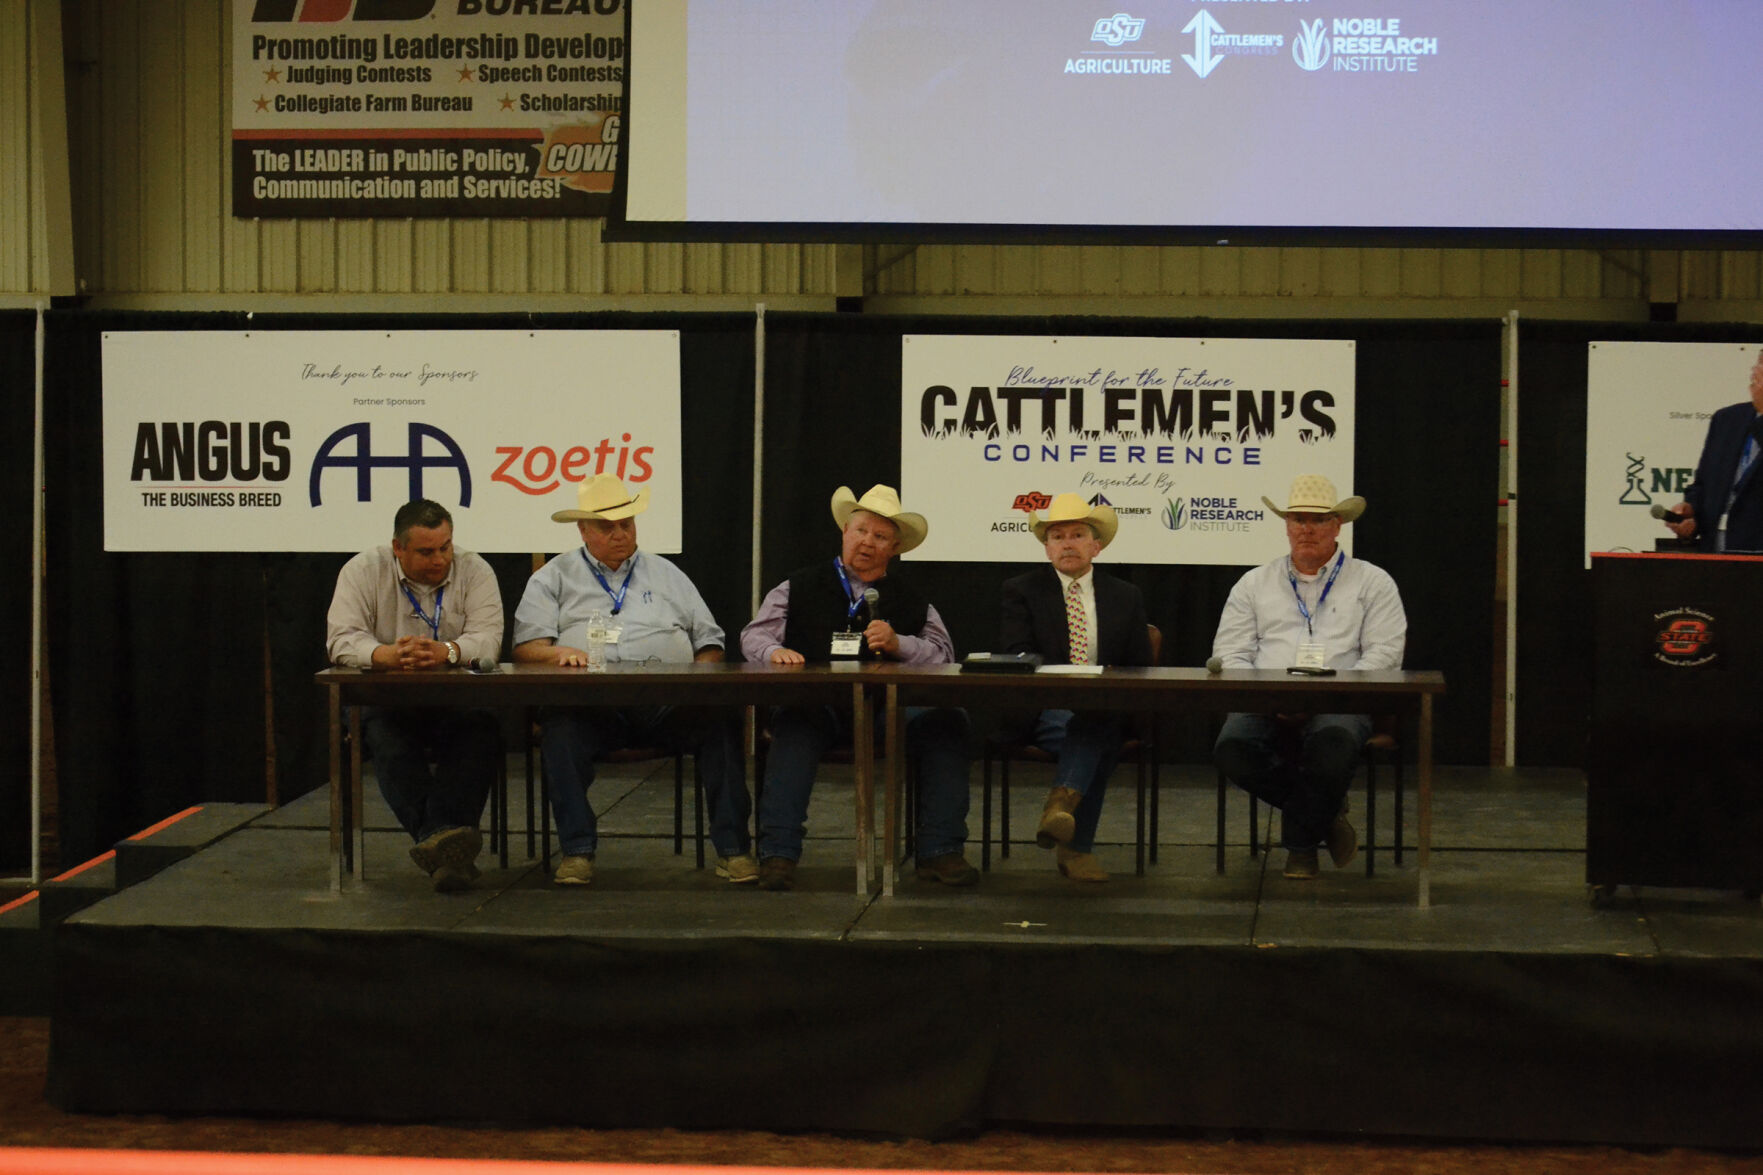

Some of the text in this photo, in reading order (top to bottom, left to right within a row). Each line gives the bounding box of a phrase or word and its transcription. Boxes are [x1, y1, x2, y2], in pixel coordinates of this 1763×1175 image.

[1333, 19, 1401, 36] NOBLE
[252, 33, 623, 62] Promoting Leadership Develop
[1211, 34, 1284, 46] CATTLEMEN'S
[1333, 37, 1438, 54] RESEARCH
[478, 64, 622, 83] Speech Contests
[1064, 59, 1172, 74] AGRICULTURE
[1333, 56, 1418, 72] INSTITUTE
[286, 65, 433, 84] Judging Contests
[274, 94, 473, 113] Collegiate Farm Bureau
[252, 149, 530, 174] The LEADER in Public Policy,
[253, 175, 561, 199] Communication and Services!
[302, 363, 479, 386] Thank you to our Sponsors
[1004, 366, 1235, 394] Blueprint for the Future
[353, 398, 426, 407] Partner Sponsors
[920, 385, 1337, 444] CATTLEMEN'S
[131, 421, 291, 482] ANGUS
[984, 445, 1261, 465] CONFERENCE
[491, 433, 655, 496] zoetis
[1080, 471, 1176, 494] Presented By
[1651, 468, 1697, 493] NE
[142, 492, 282, 507] THE BUSINESS BREED
[1190, 497, 1238, 508] NOBLE
[1113, 507, 1152, 515] TTLEMEN'S
[1190, 510, 1264, 521] RESEARCH
[1190, 521, 1251, 532] INSTITUTE
